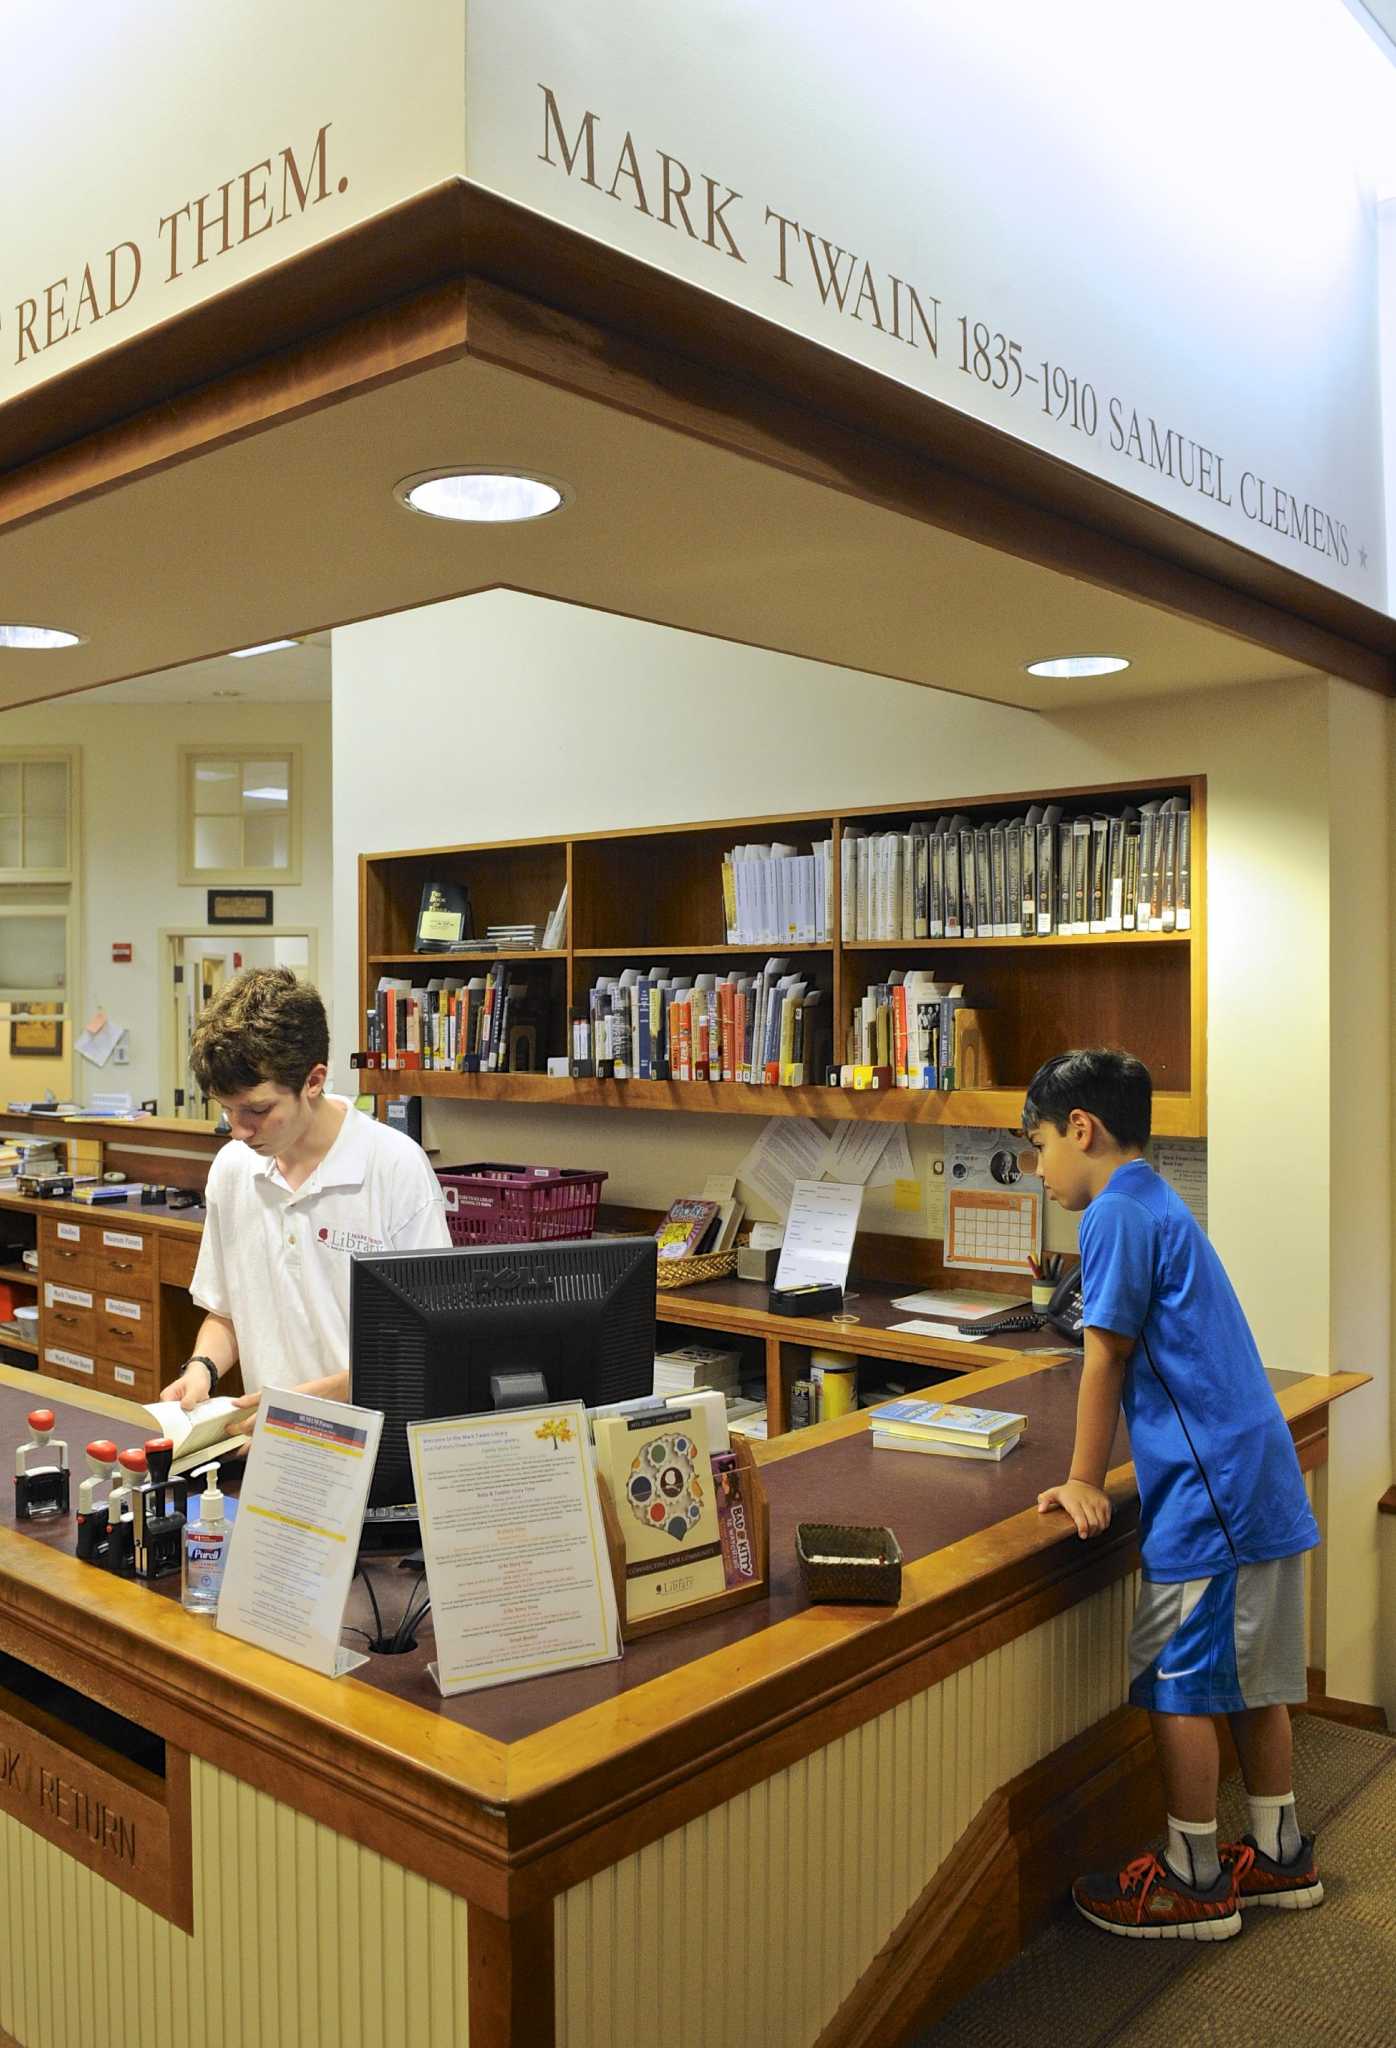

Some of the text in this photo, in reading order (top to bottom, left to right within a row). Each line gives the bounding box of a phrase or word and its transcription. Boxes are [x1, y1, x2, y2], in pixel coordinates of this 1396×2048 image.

[14, 123, 348, 365] READ THEM.
[537, 83, 748, 264] MARK
[764, 205, 942, 358] TWAIN
[1109, 397, 1231, 508] SAMUEL
[1240, 471, 1350, 568] CLEMENS
[194, 1549, 219, 1559] Purell
[731, 1506, 751, 1575] BAD KITTY
[40, 1767, 136, 1866] RETURN
